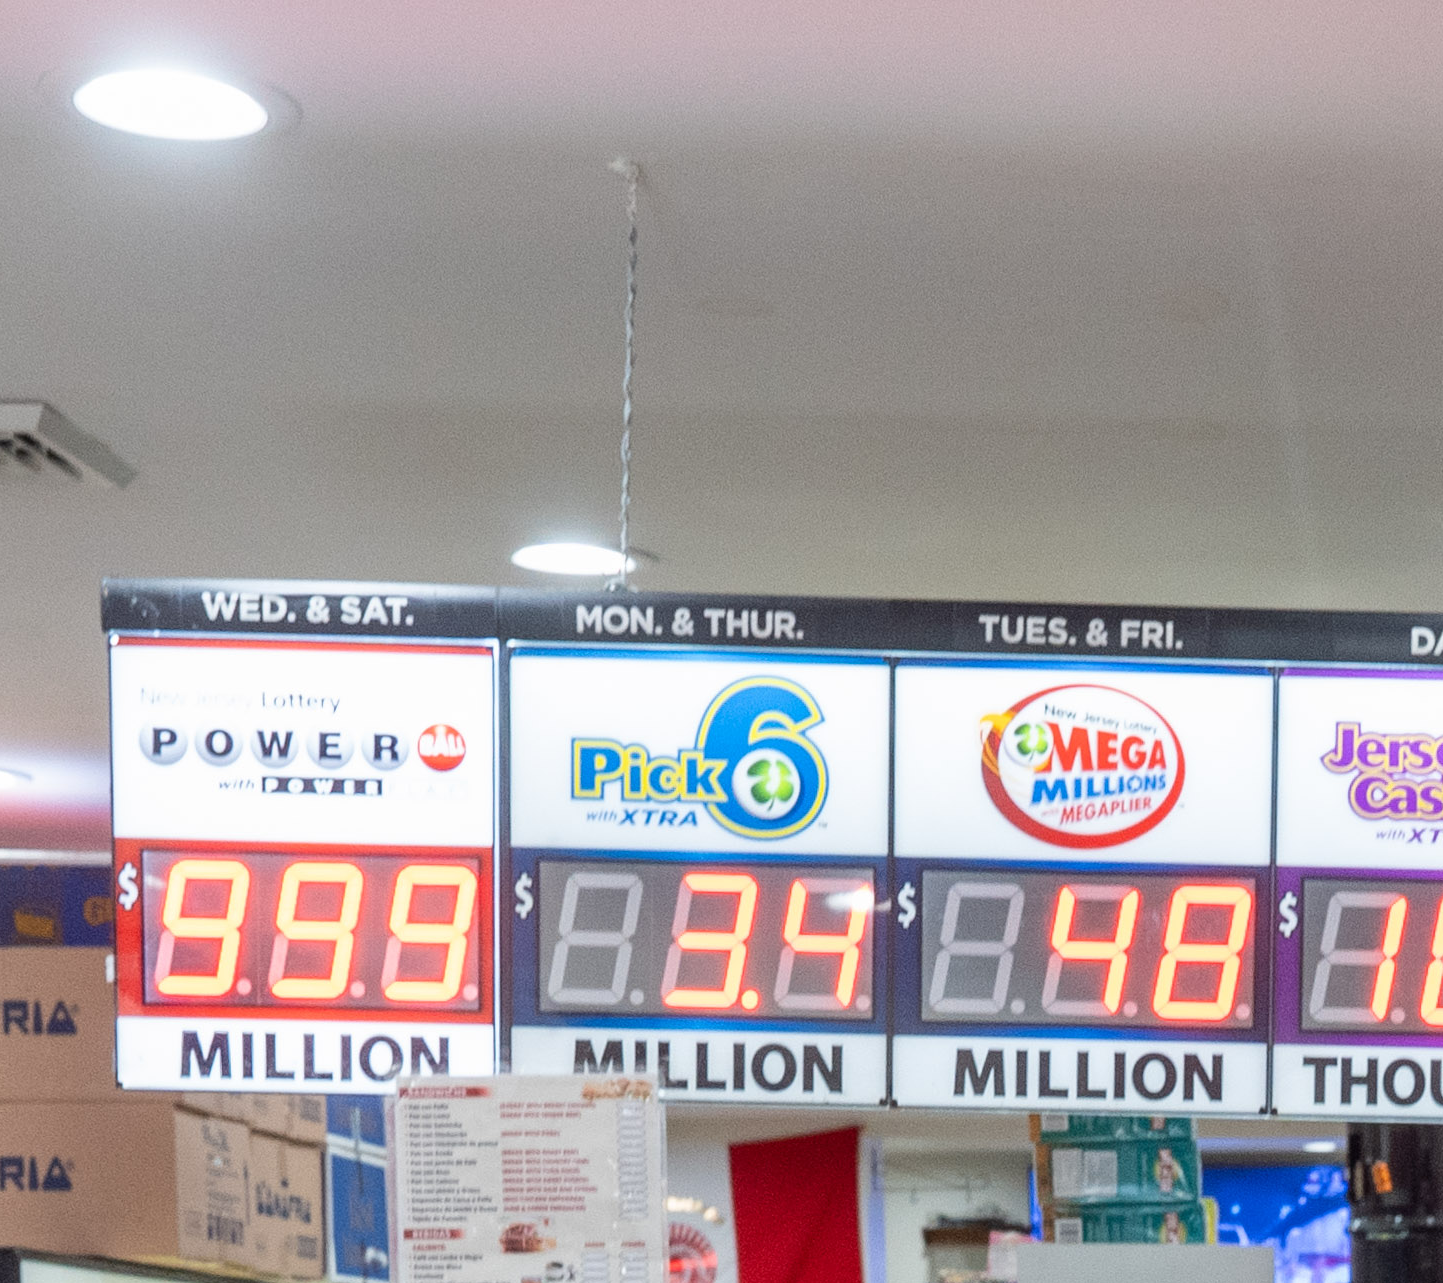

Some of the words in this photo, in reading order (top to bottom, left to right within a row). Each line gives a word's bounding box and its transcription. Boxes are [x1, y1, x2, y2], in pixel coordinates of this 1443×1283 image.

[202, 591, 296, 624] WED.
[307, 595, 330, 624] &
[340, 596, 415, 627] SAT.
[575, 605, 663, 637] MON.
[672, 608, 696, 638] &
[703, 607, 806, 643] THUR.
[979, 615, 1076, 647] TUES.
[1085, 618, 1110, 647] &
[1120, 619, 1184, 652] FRI.
[261, 691, 341, 714] Lottery
[571, 737, 727, 802] Pick
[697, 675, 830, 841] 6
[1034, 721, 1167, 774] MEGA
[1030, 773, 1167, 806] MILLIONS
[619, 808, 701, 828] XTRA
[1059, 797, 1153, 826] MEGAPLIER
[179, 1031, 451, 1082] MILLION
[573, 1039, 845, 1094] MILLION
[953, 1049, 1225, 1103] MILLION
